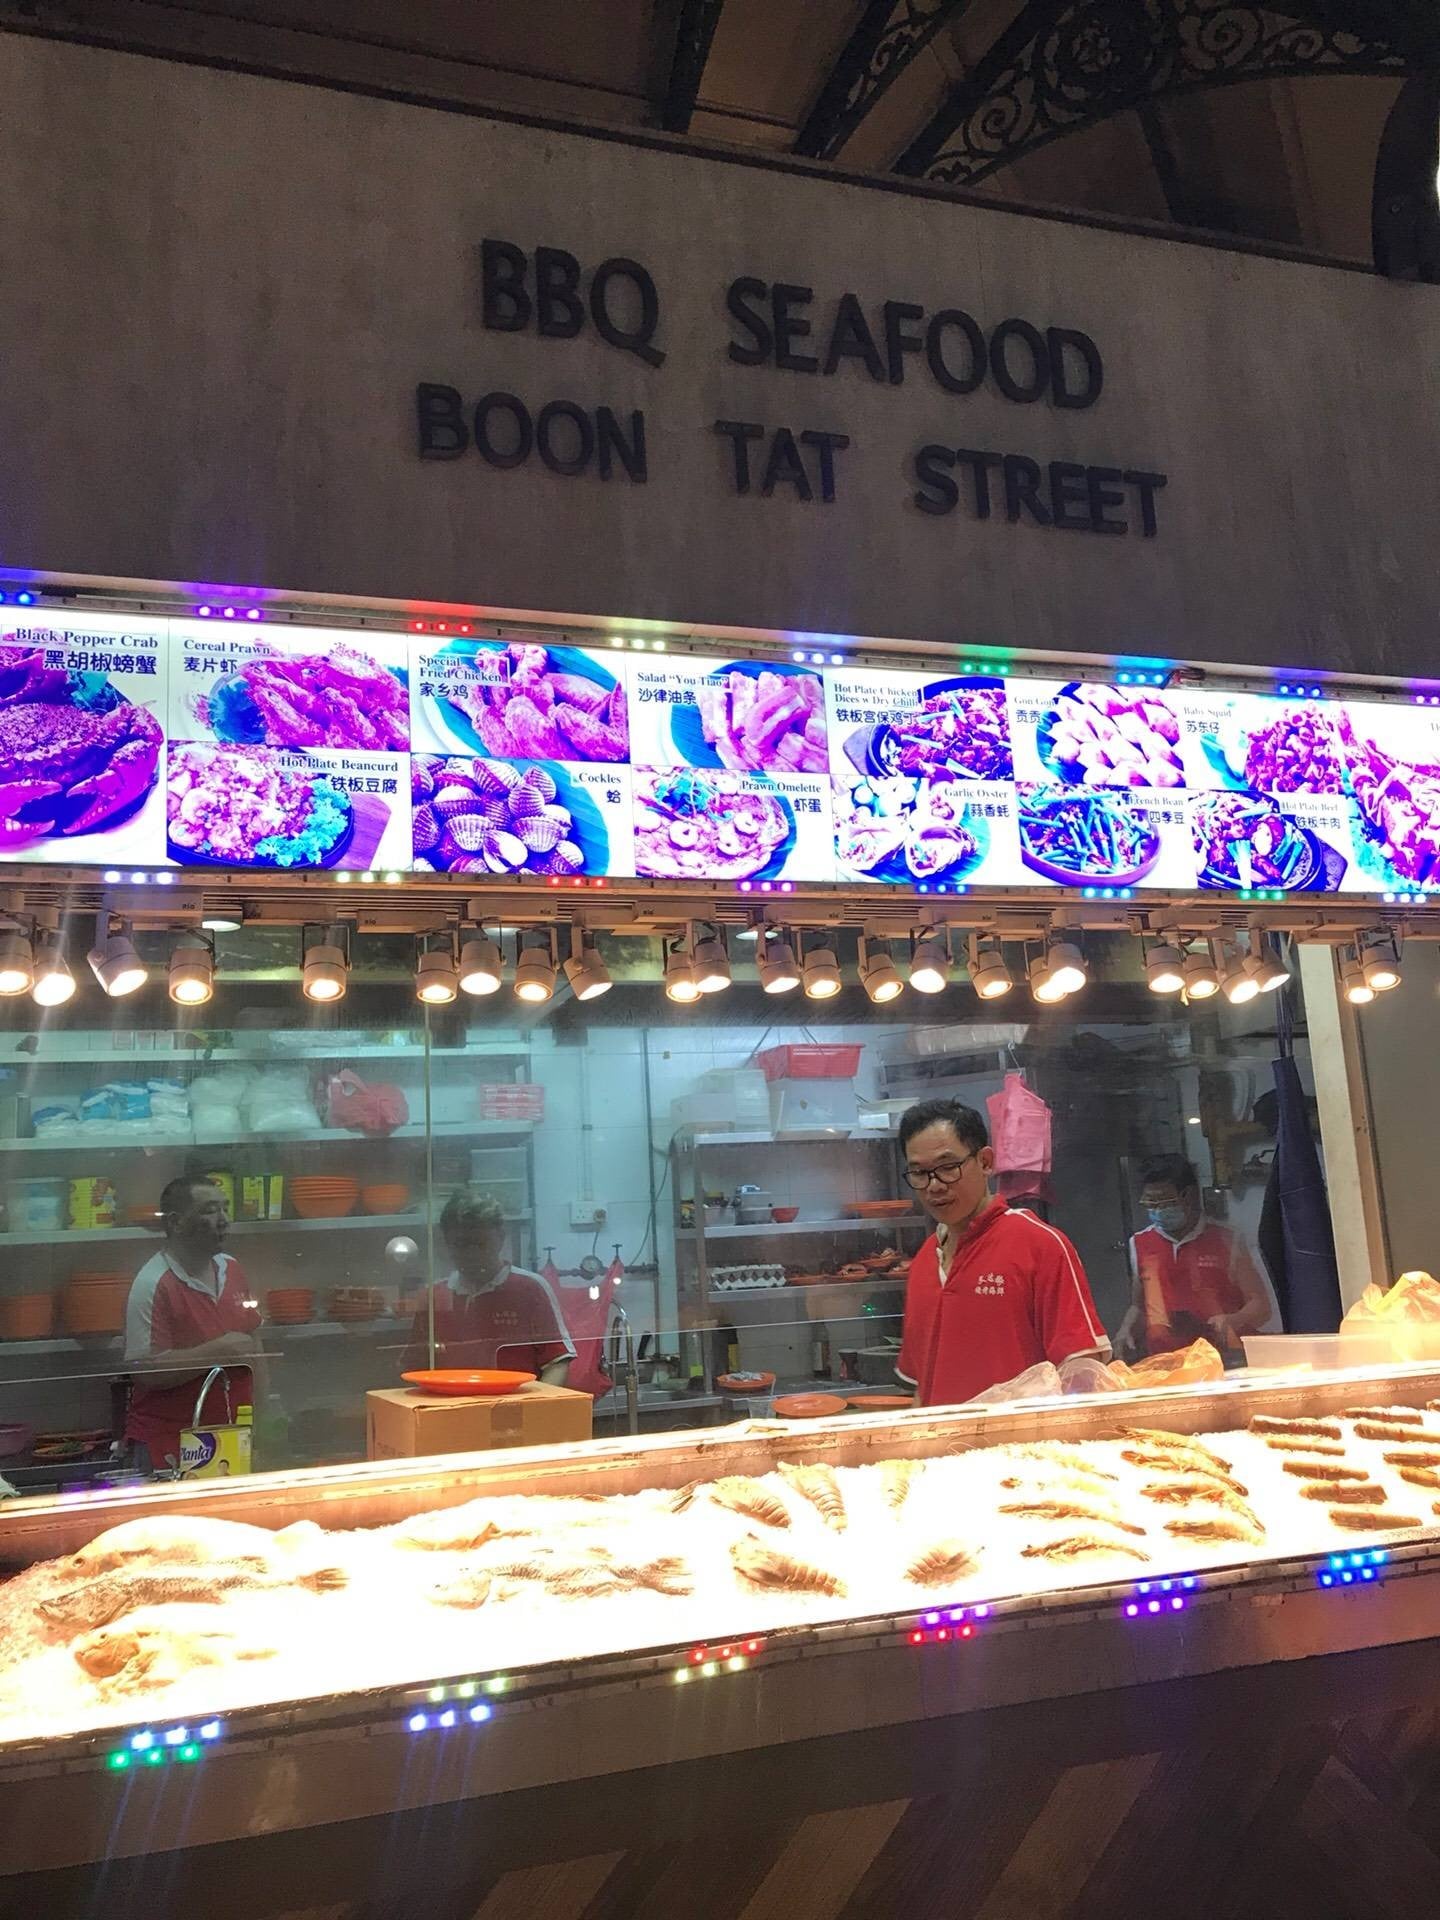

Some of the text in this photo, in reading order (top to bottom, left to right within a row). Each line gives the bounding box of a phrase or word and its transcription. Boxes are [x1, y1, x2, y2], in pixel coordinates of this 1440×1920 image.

[482, 238, 1104, 409] BBQ SEAFOOD
[416, 382, 1168, 538] BOON TAT STREET
[16, 628, 158, 648] Black Pepper Crab
[184, 639, 270, 654] Cereal Prawn
[44, 650, 157, 675] 黑胡椒螃蟹
[183, 656, 238, 673] 麦片虾
[419, 655, 461, 667] Special
[420, 667, 501, 682] Fried Chicken
[637, 672, 666, 683] Salad
[419, 682, 468, 699] 家乡鸡
[638, 688, 696, 705] 沙律油条
[834, 683, 917, 697] Hot Plate Chicken
[835, 694, 859, 703] Dices
[281, 756, 398, 772] Hot Plate Beancurd
[330, 776, 398, 793] 铁板豆腐
[579, 773, 621, 783] Cockles
[742, 780, 821, 793] Prawn Omelette
[944, 788, 1008, 799] Garlic Oyster
[794, 798, 821, 812] 虾蛋
[1149, 810, 1185, 824] 四季豆
